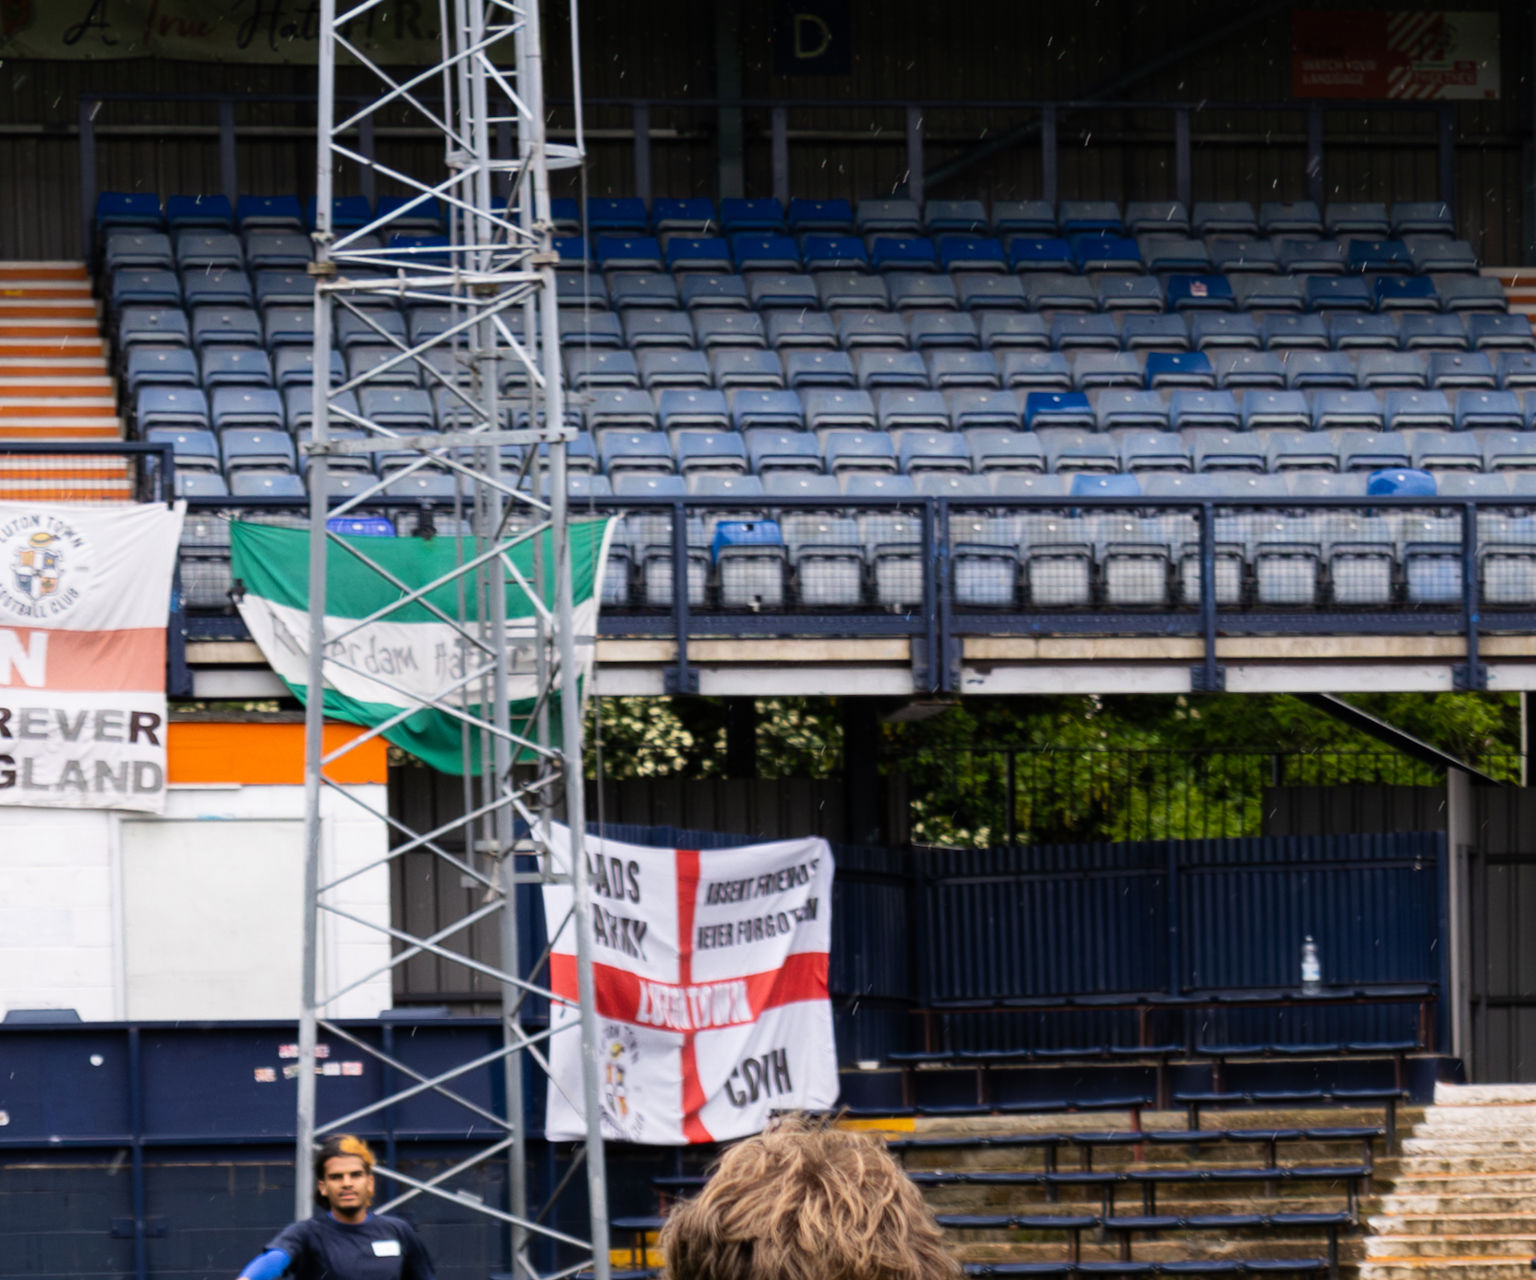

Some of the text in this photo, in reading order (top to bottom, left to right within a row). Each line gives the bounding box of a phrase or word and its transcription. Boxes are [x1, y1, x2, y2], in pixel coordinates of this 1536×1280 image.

[793, 13, 831, 60] D
[47, 516, 85, 548] TOWN
[50, 586, 80, 614] CLUB
[592, 903, 648, 962] ARMY
[737, 897, 819, 945] FORGOTEN
